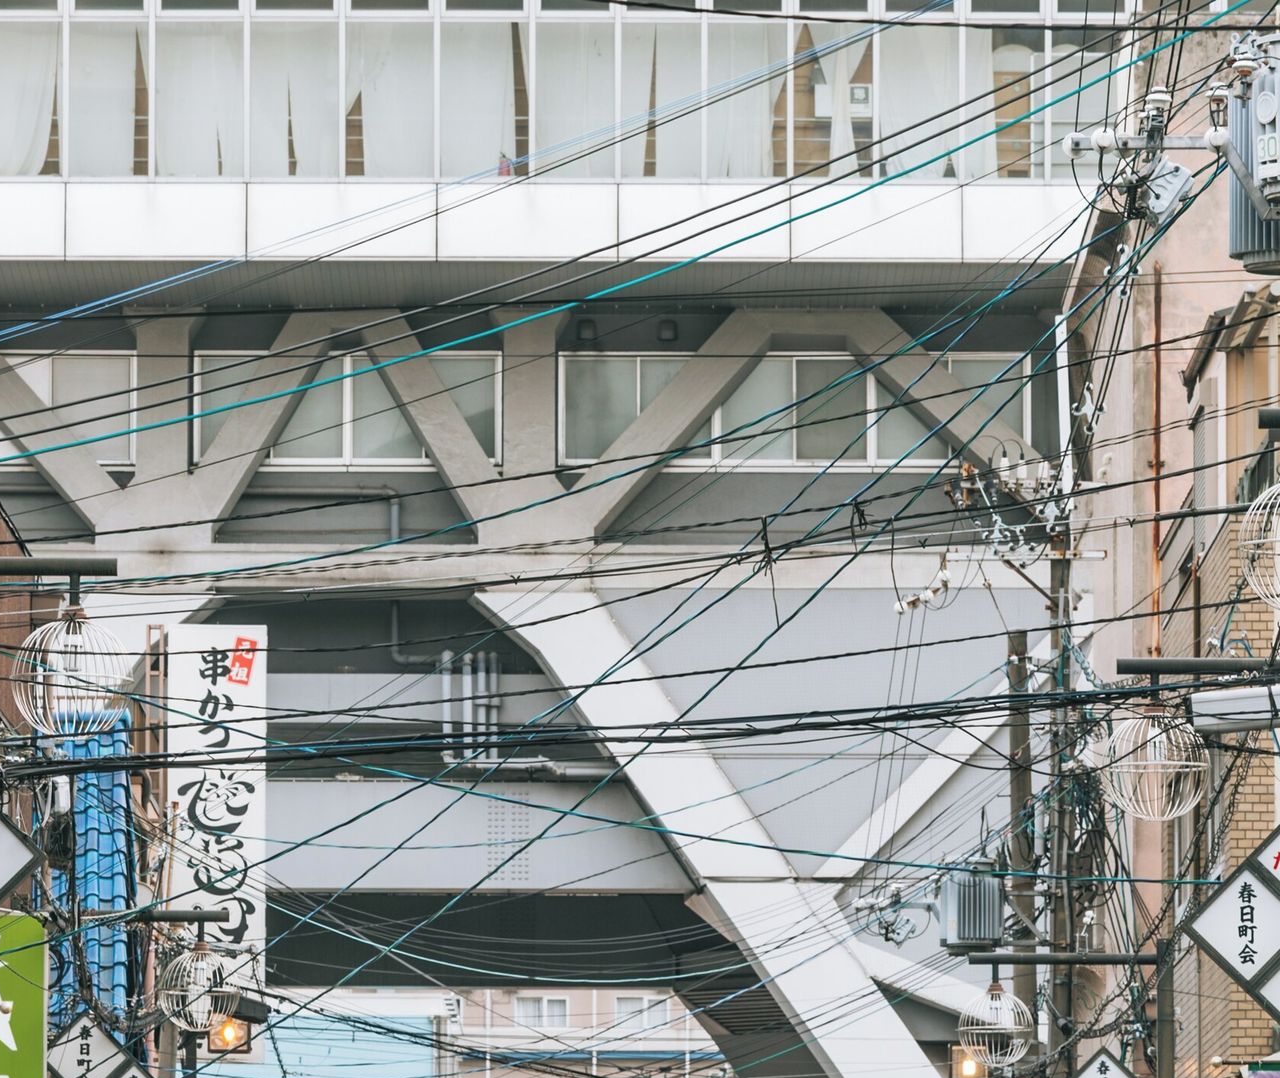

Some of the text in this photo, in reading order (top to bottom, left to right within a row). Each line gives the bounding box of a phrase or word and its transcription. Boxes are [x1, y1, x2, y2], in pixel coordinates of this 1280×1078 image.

[198, 647, 234, 748] 串かつ
[229, 638, 254, 682] 元祖
[1237, 882, 1256, 965] 春日町会
